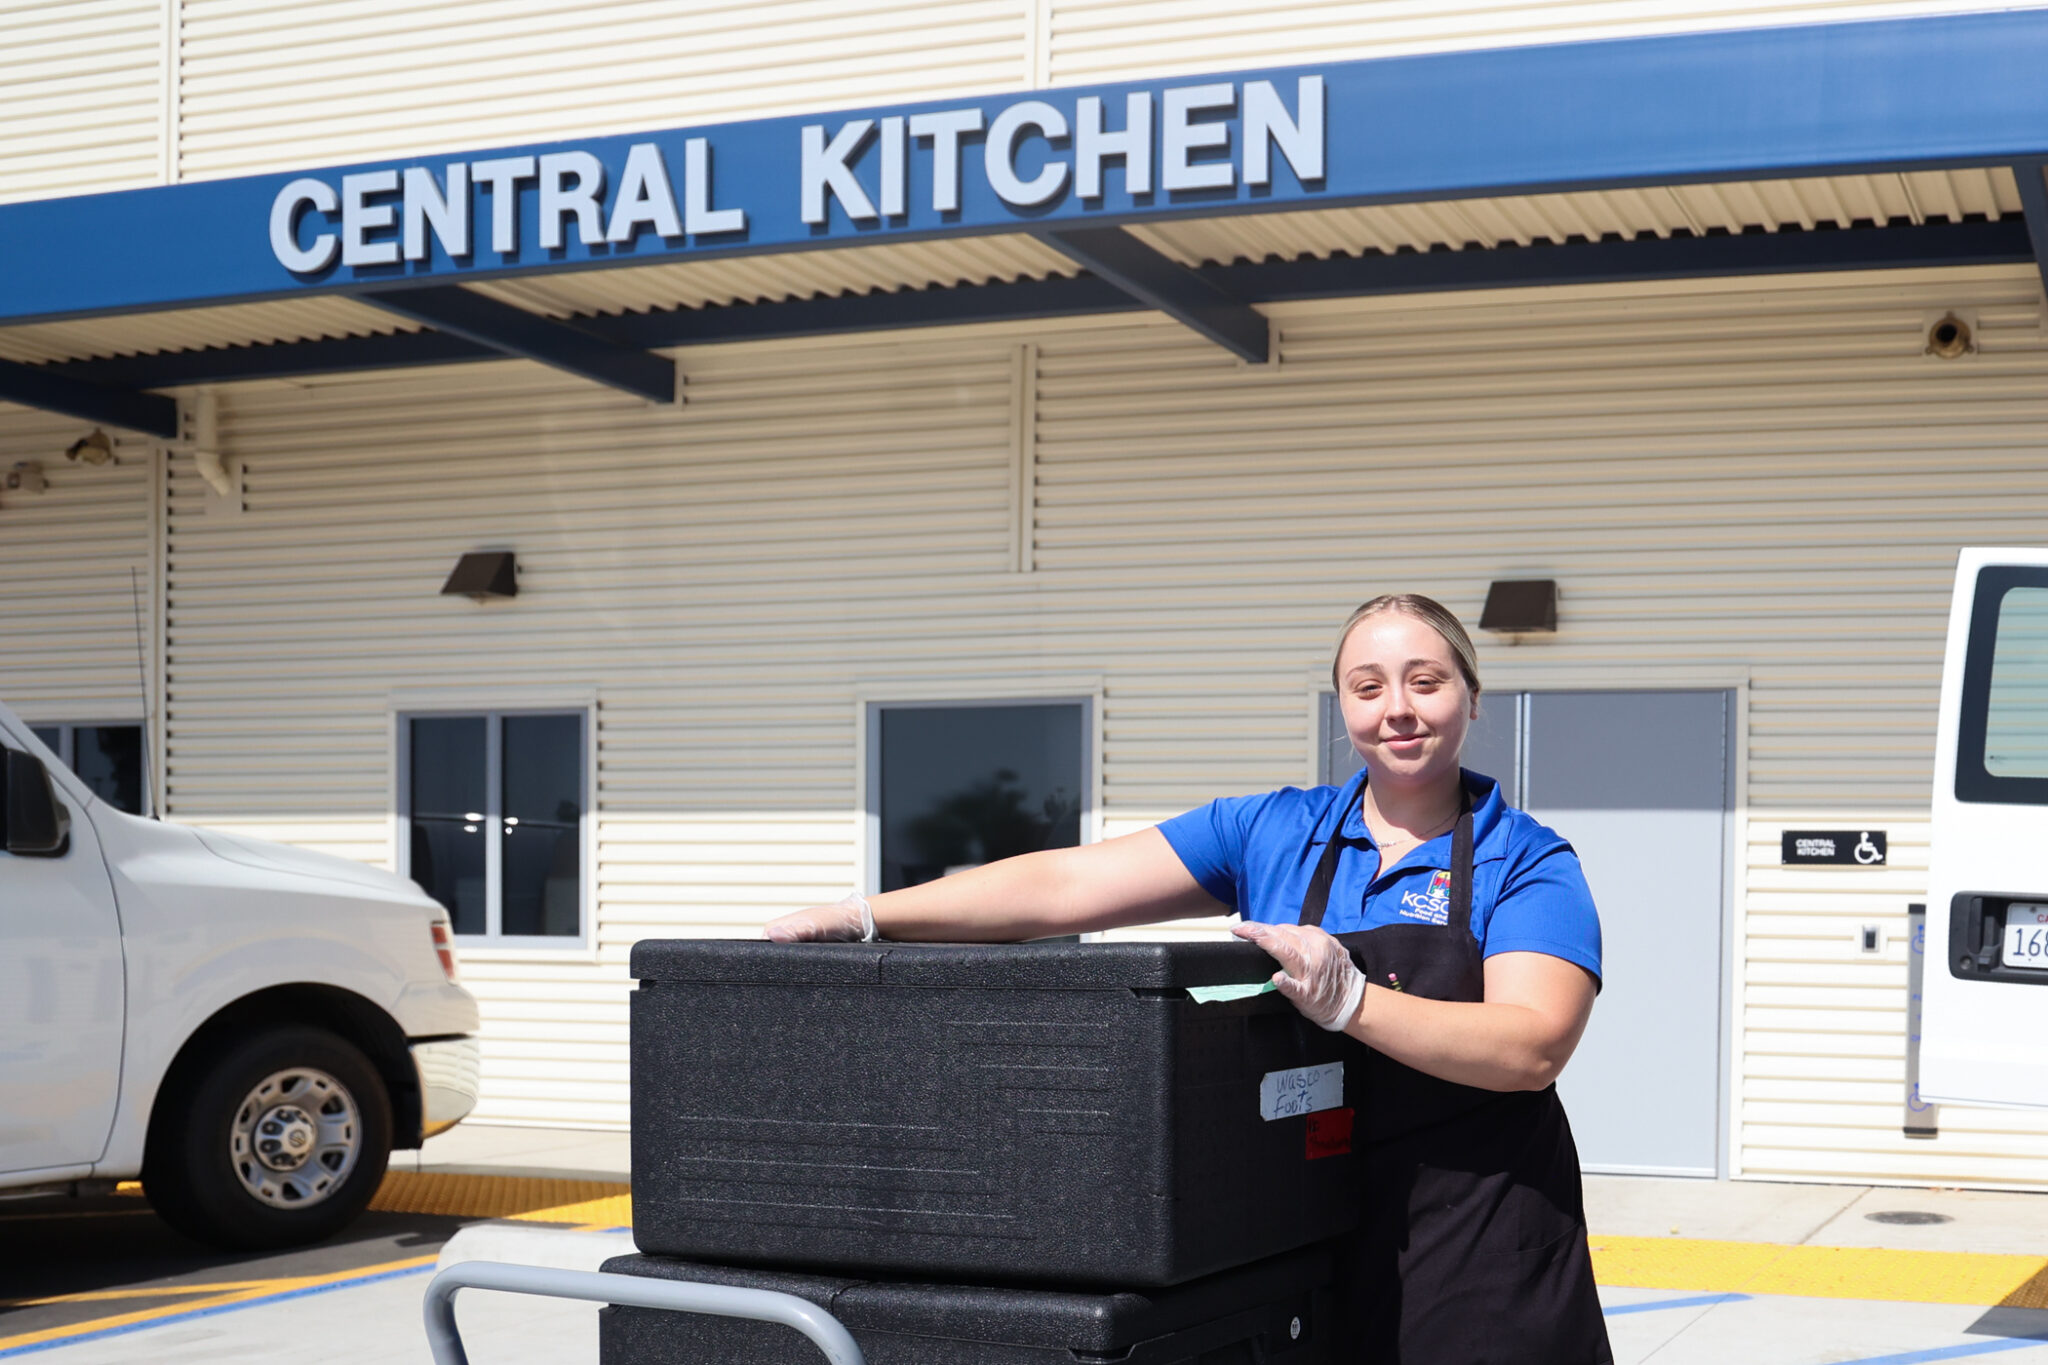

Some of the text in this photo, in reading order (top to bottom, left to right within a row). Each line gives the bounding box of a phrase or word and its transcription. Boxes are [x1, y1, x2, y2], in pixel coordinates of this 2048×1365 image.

[269, 74, 1325, 275] CENTRAL KITCHEN
[1795, 838, 1835, 848] CENTRAL
[1796, 847, 1835, 856] KITCHEN
